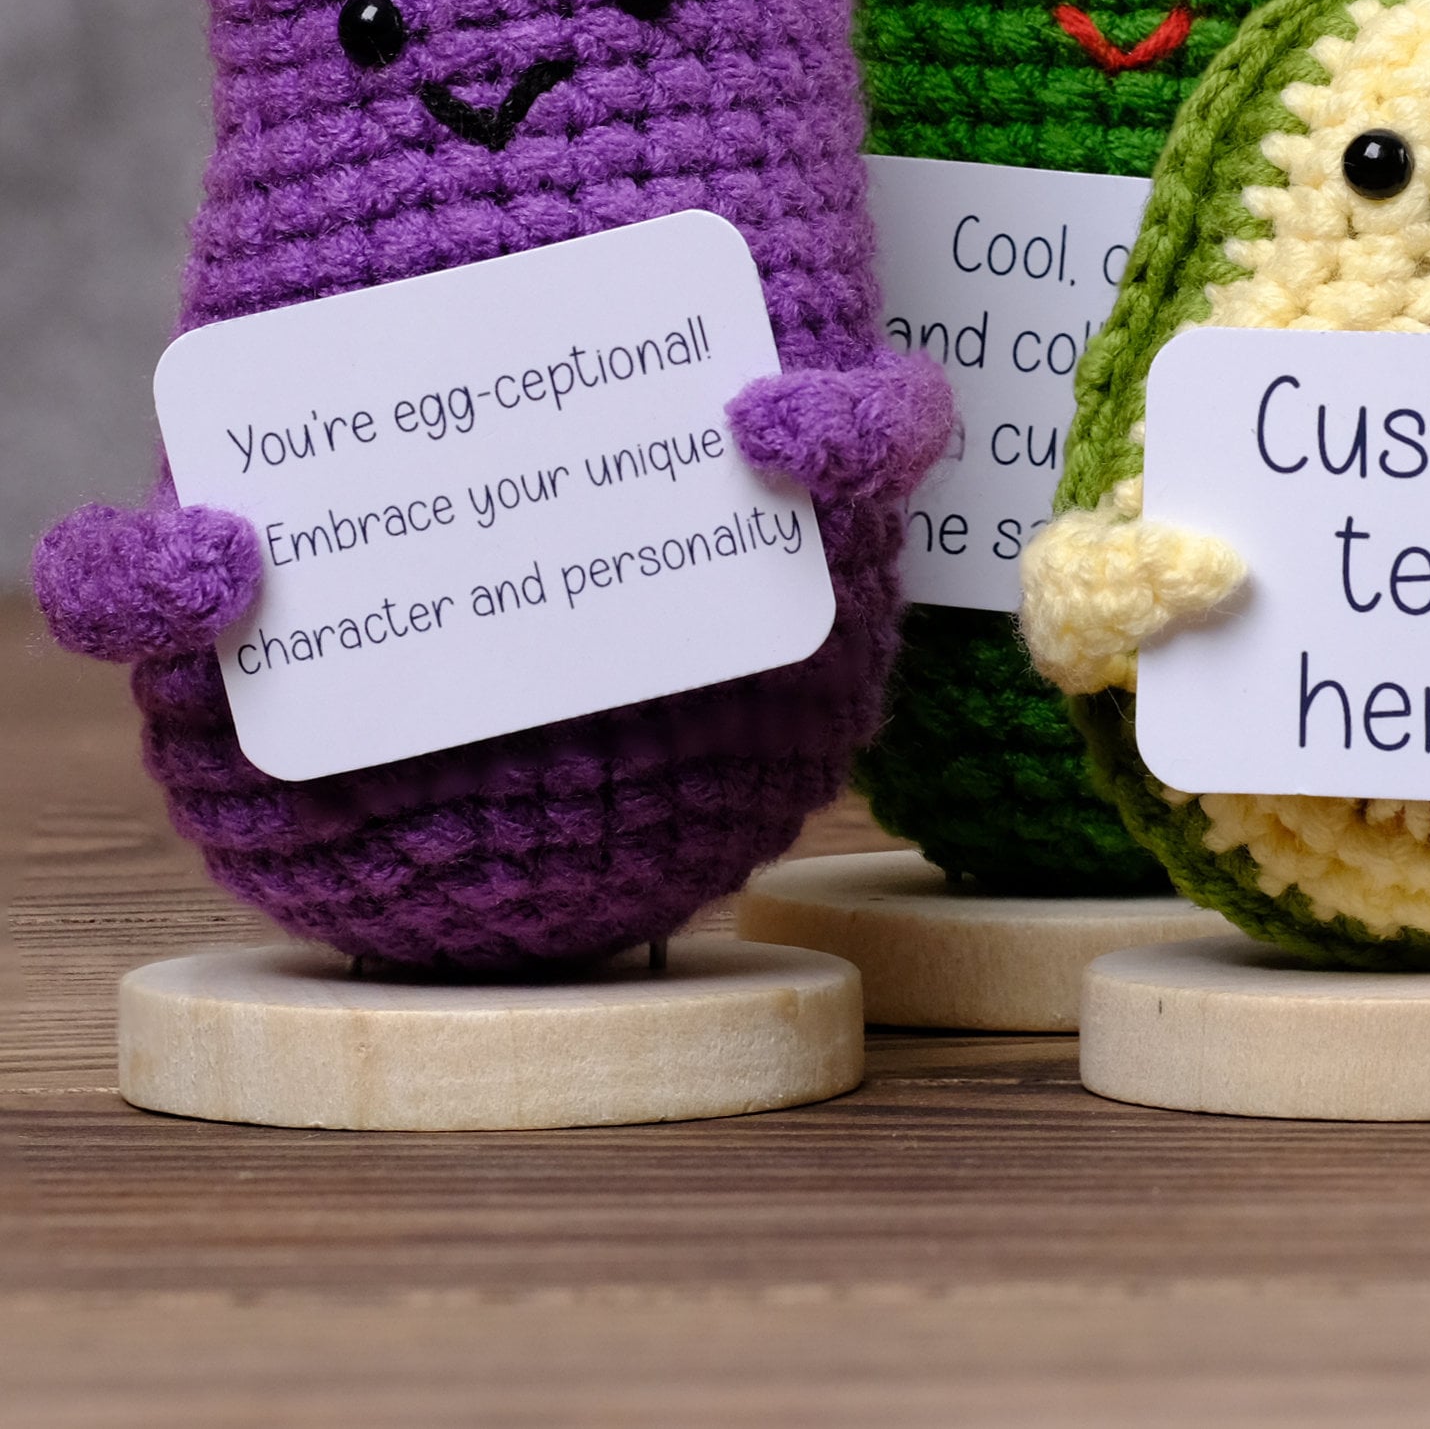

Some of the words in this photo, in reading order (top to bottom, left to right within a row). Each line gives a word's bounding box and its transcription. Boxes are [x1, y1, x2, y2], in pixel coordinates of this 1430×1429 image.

[953, 214, 1076, 287] Cool,
[226, 408, 377, 474] You're
[393, 314, 712, 441] egg-ceptional!
[265, 491, 457, 568] Embrace
[468, 462, 571, 529] your
[584, 425, 725, 487] unique
[237, 595, 456, 675] character
[470, 560, 548, 618] and
[560, 505, 803, 610] personality
